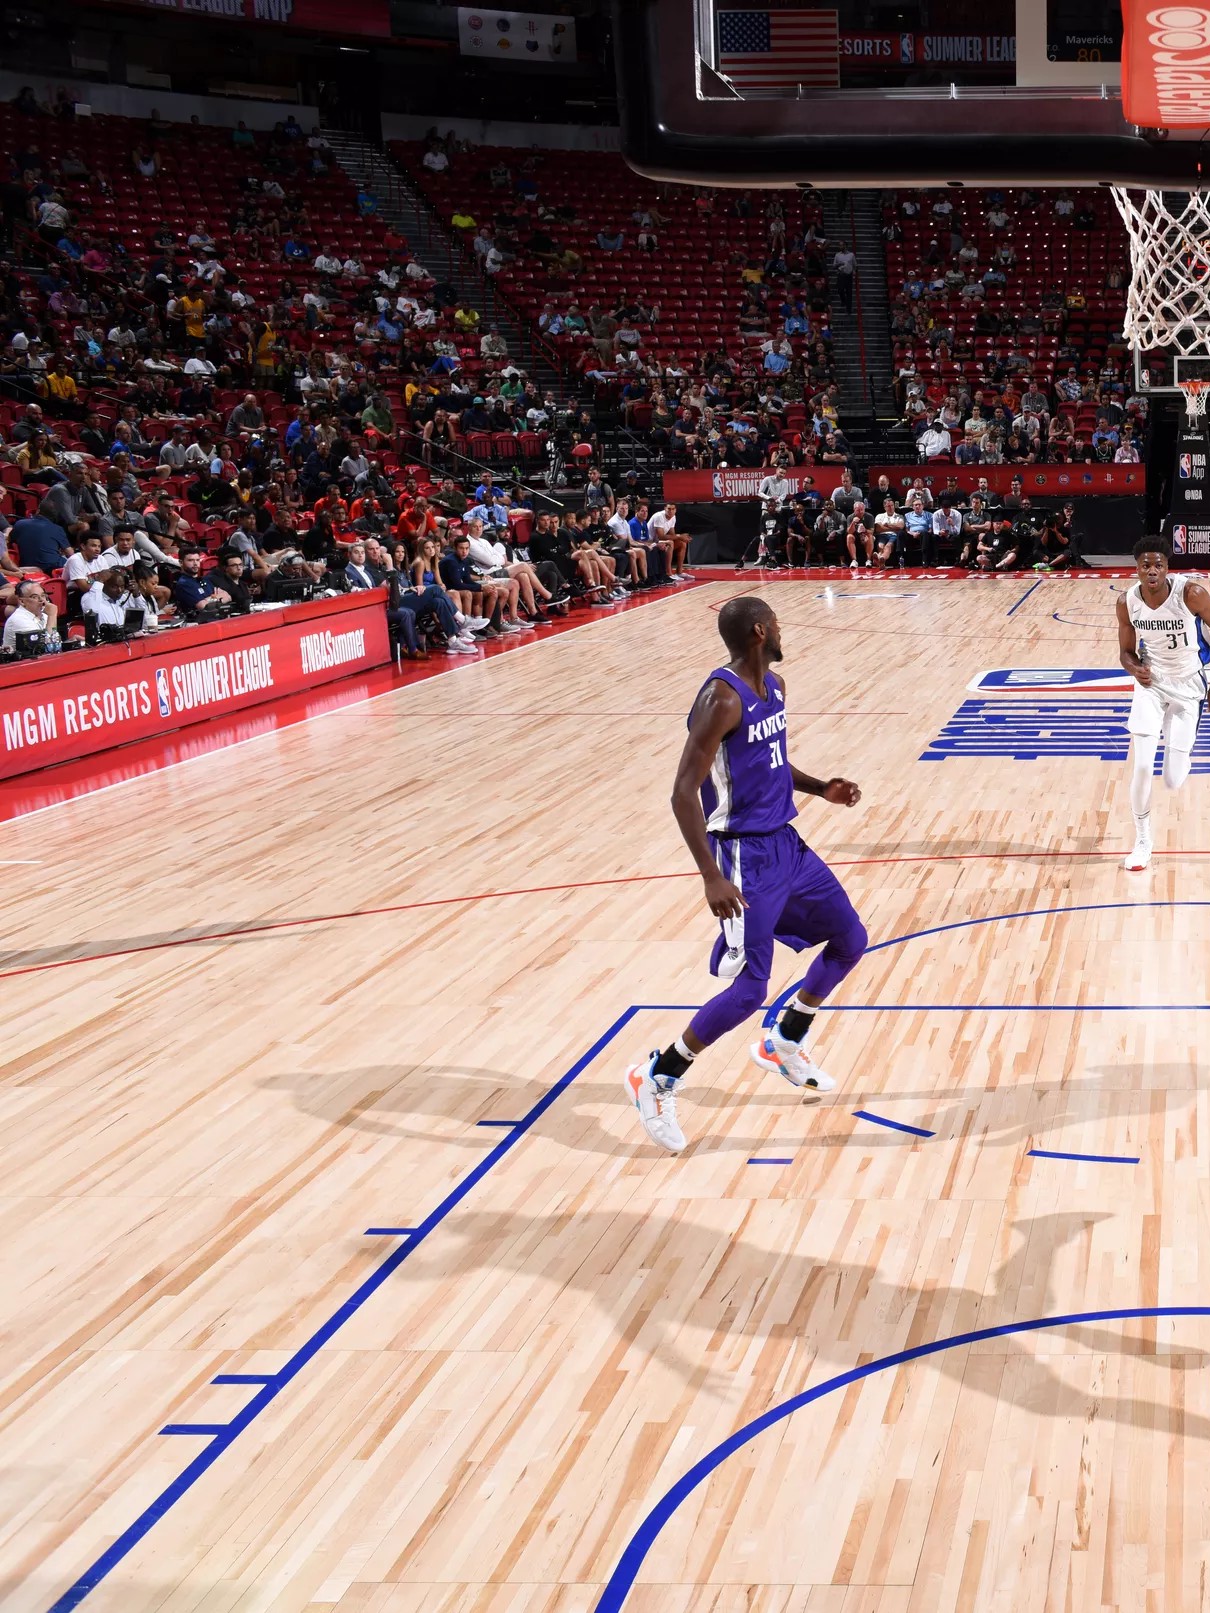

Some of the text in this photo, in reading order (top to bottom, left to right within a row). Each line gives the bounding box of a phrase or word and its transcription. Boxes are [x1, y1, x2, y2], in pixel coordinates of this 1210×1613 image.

[1065, 34, 1114, 45] Mavericks
[923, 35, 983, 62] SUMMER
[986, 36, 1016, 62] LEAG
[1192, 453, 1207, 466] NBA
[724, 471, 765, 480] MGM RESORTS
[1192, 466, 1205, 480] App
[725, 479, 760, 497] SUMME
[1184, 489, 1203, 501] @NBA
[1188, 542, 1210, 555] LEAGUE
[1166, 631, 1189, 650] 37
[300, 628, 366, 675] #NBASummer
[3, 643, 274, 751] MGM RESORTS SUMMER LEAGUE
[769, 739, 784, 769] 31
